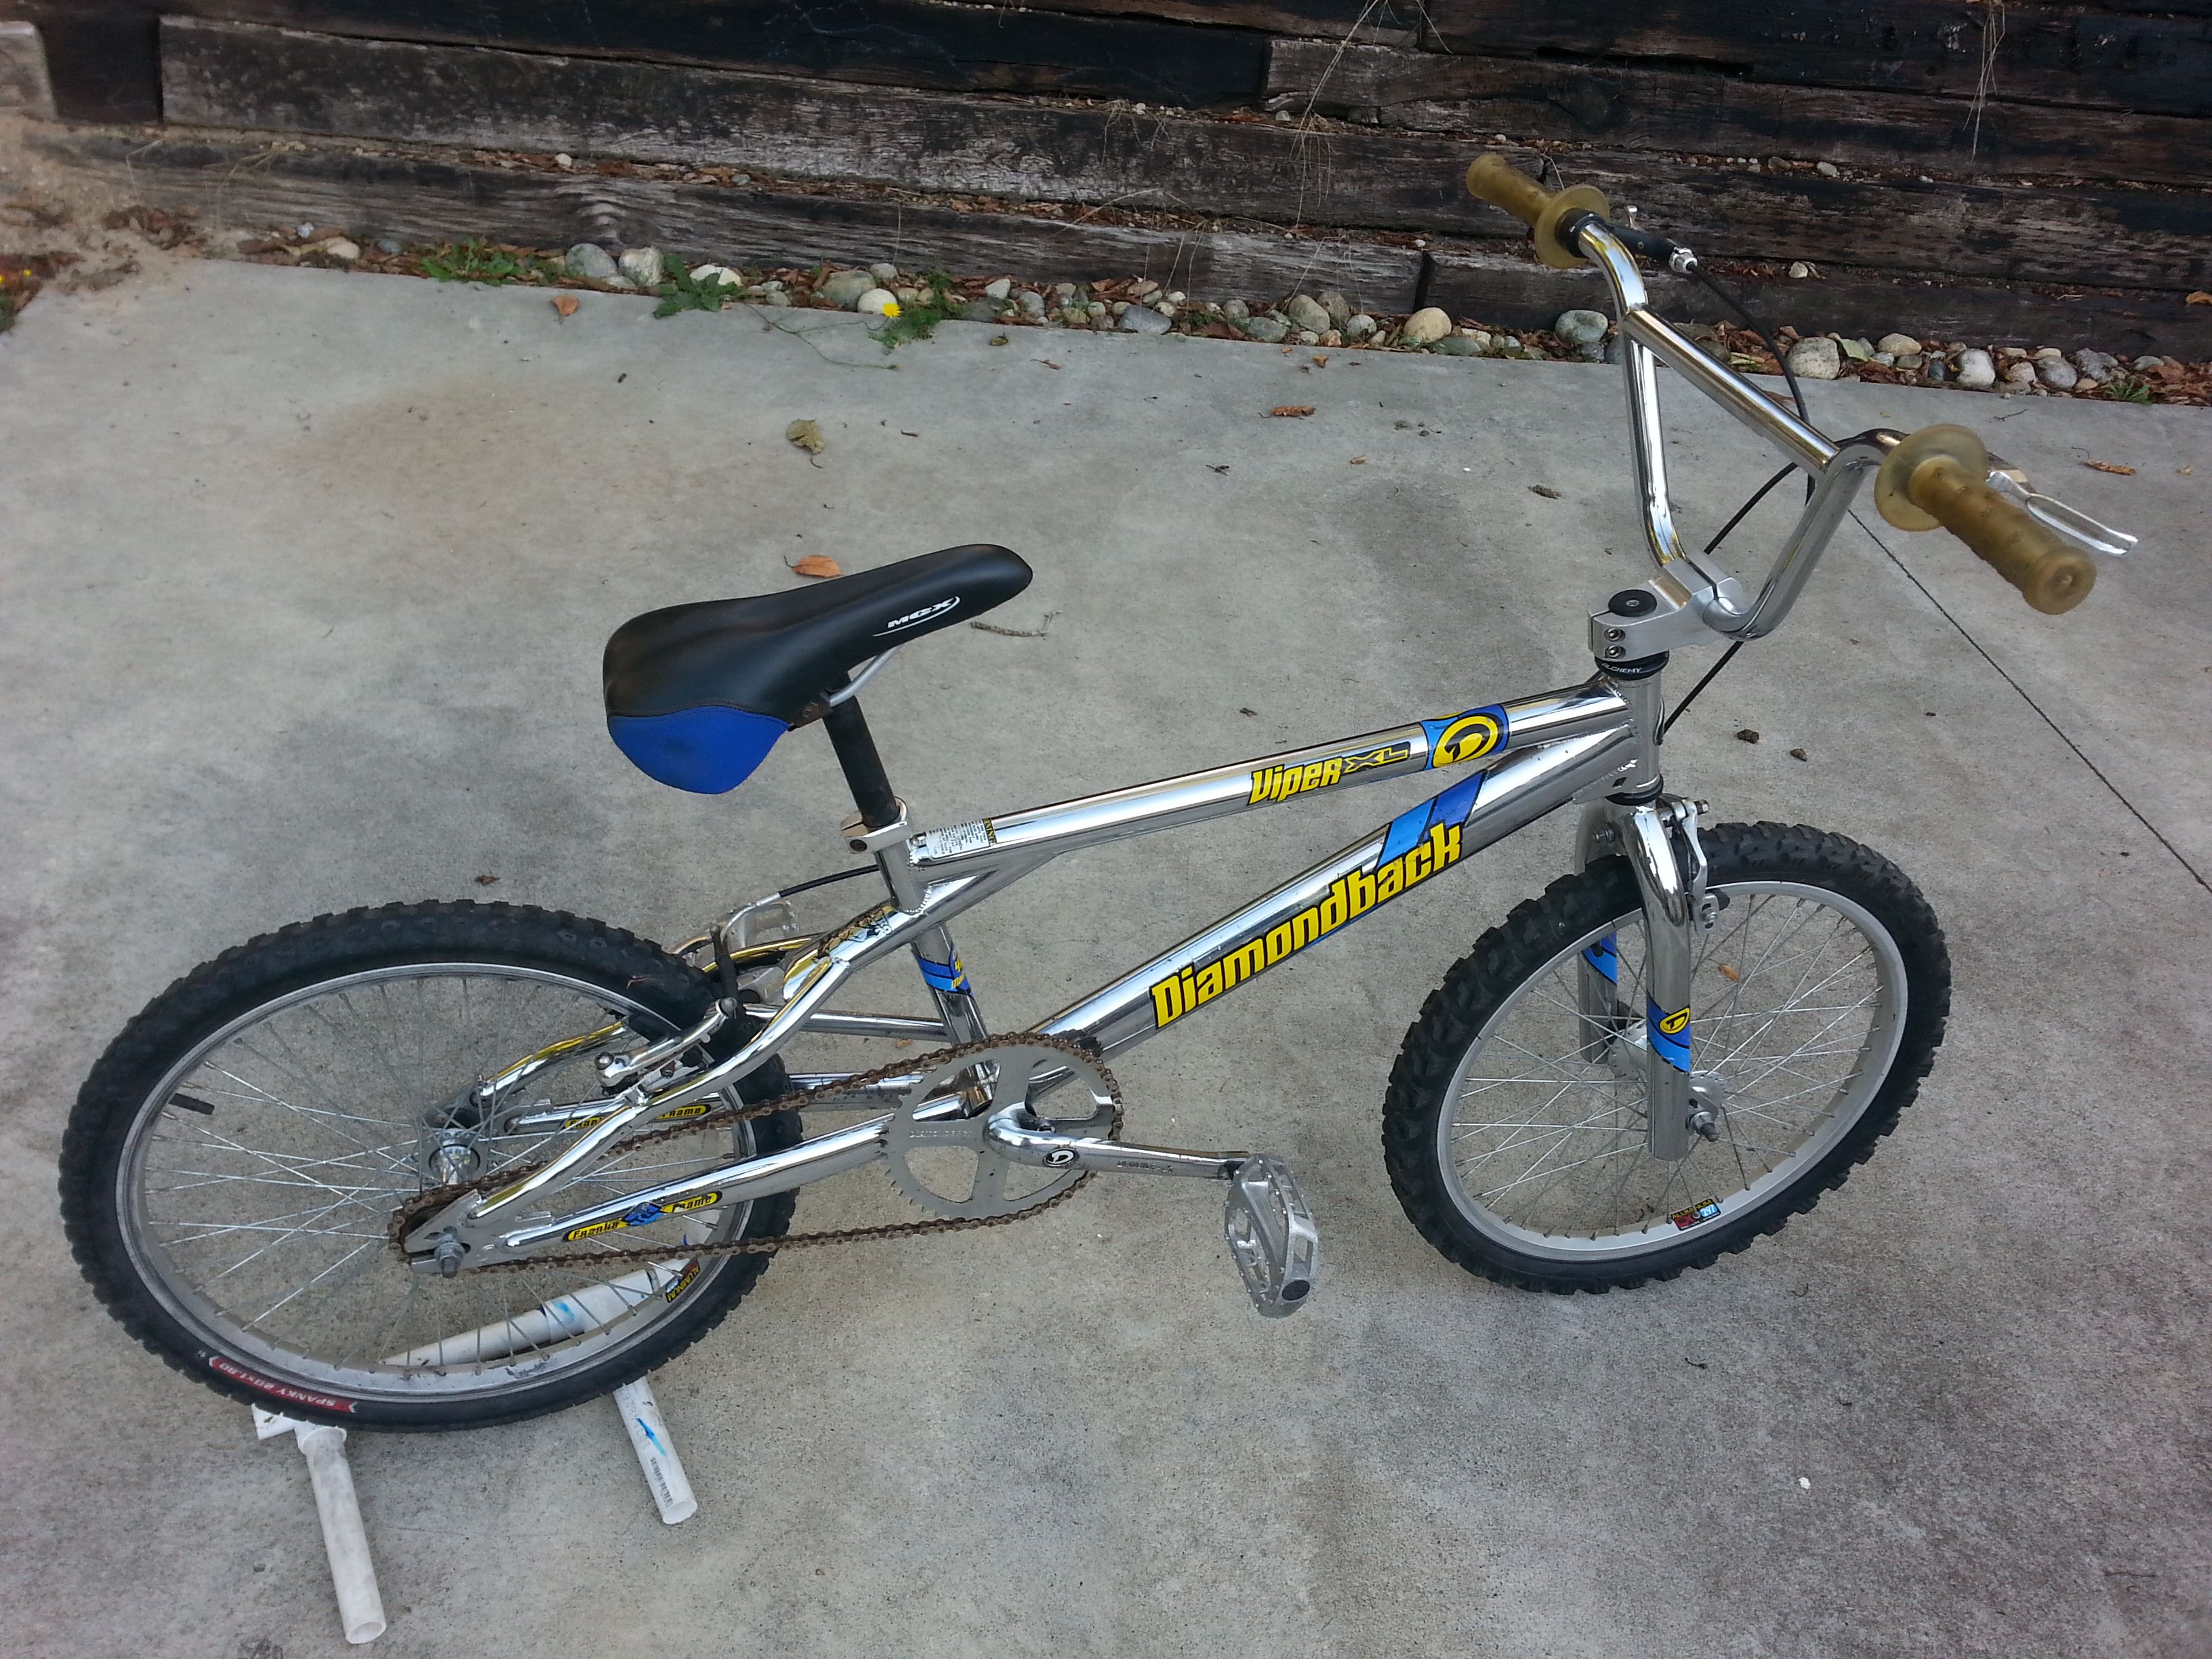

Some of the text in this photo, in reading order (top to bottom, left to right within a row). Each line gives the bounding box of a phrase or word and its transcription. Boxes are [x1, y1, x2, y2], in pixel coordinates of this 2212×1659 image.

[887, 597, 955, 629] MGX
[1601, 662, 1642, 674] ALCHEMY
[1344, 747, 1409, 774] XL
[1150, 821, 1462, 1029] Diamondback
[276, 1387, 337, 1407] SPANKY
